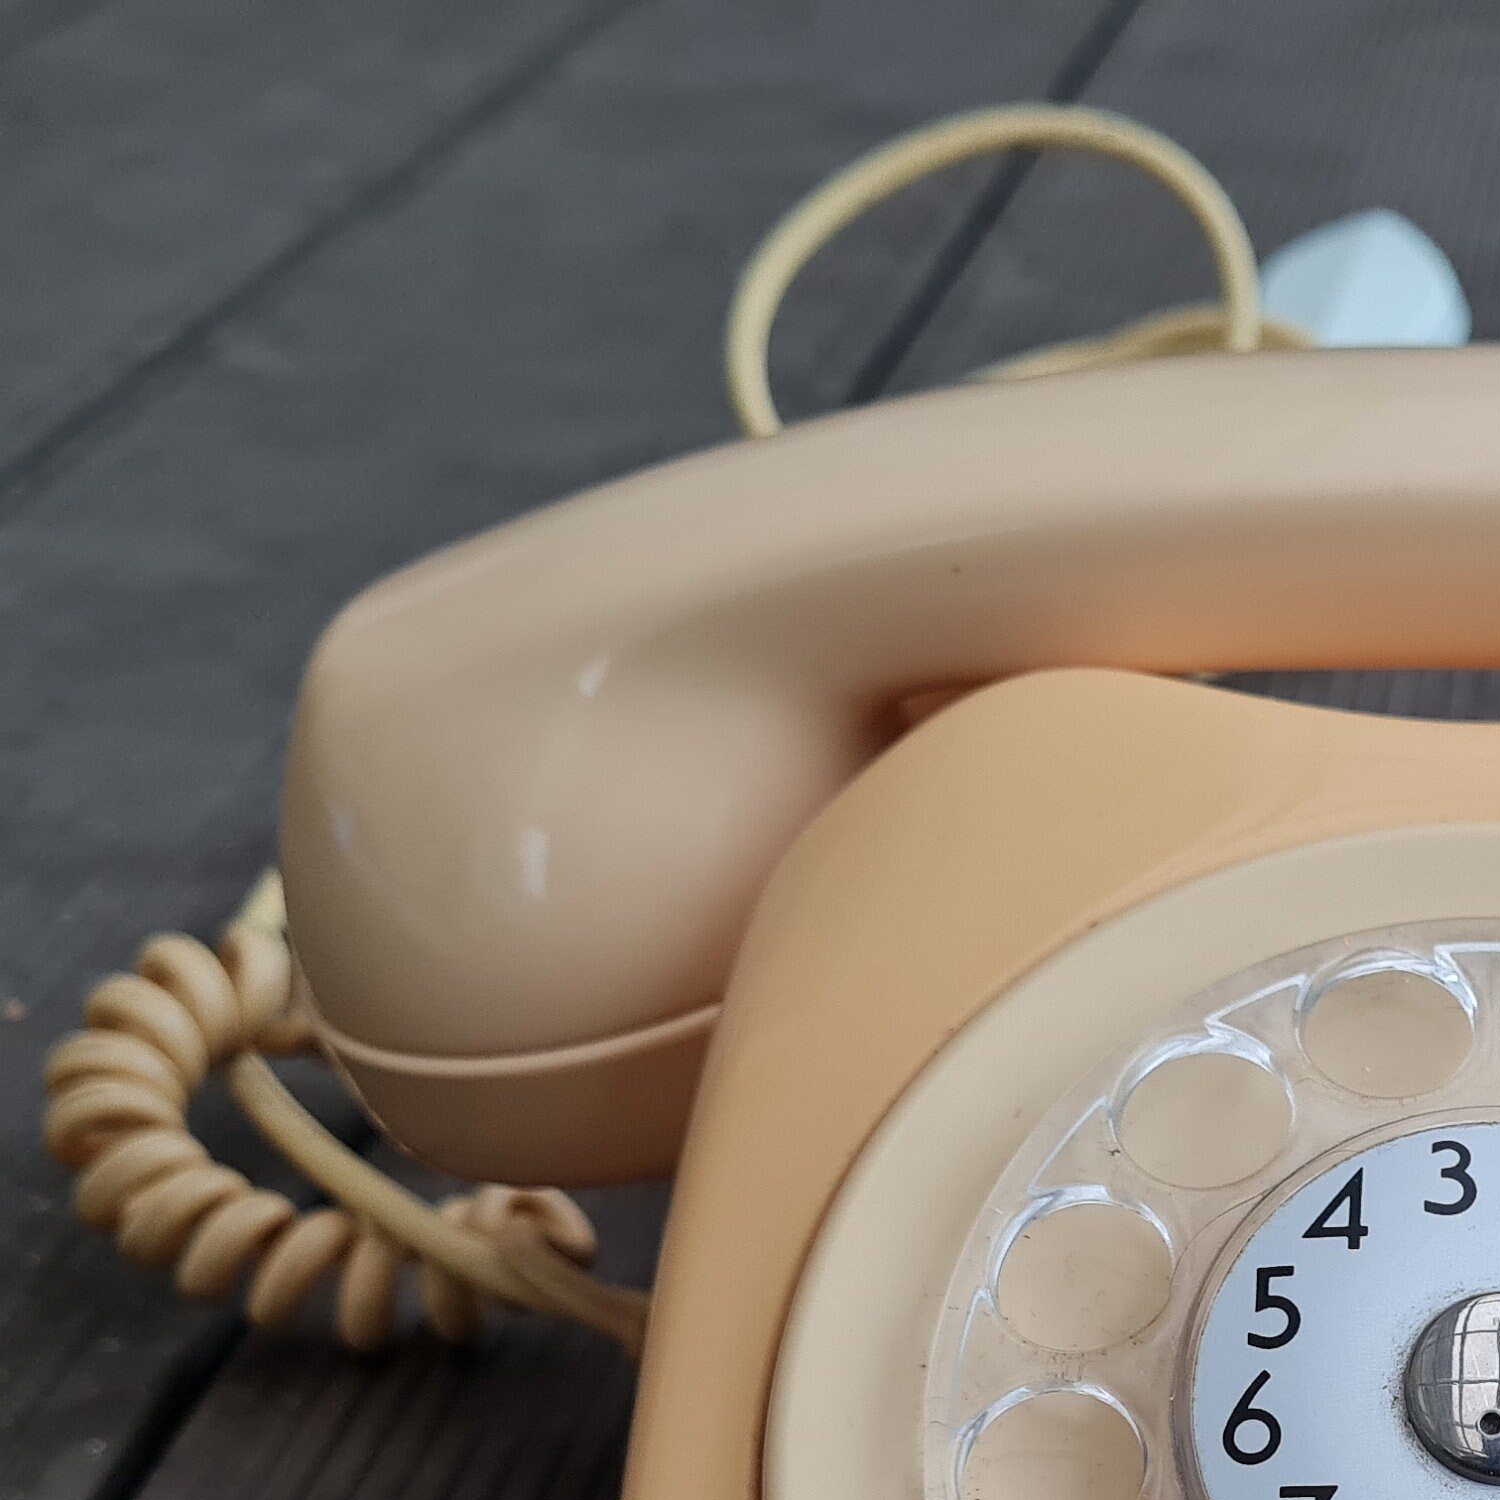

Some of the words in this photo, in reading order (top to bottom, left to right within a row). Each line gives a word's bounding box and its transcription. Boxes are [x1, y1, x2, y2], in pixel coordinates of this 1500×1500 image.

[1301, 1167, 1369, 1250] 4
[1424, 1140, 1478, 1216] 3
[1246, 1265, 1301, 1350] 5
[1222, 1369, 1282, 1466] 6
